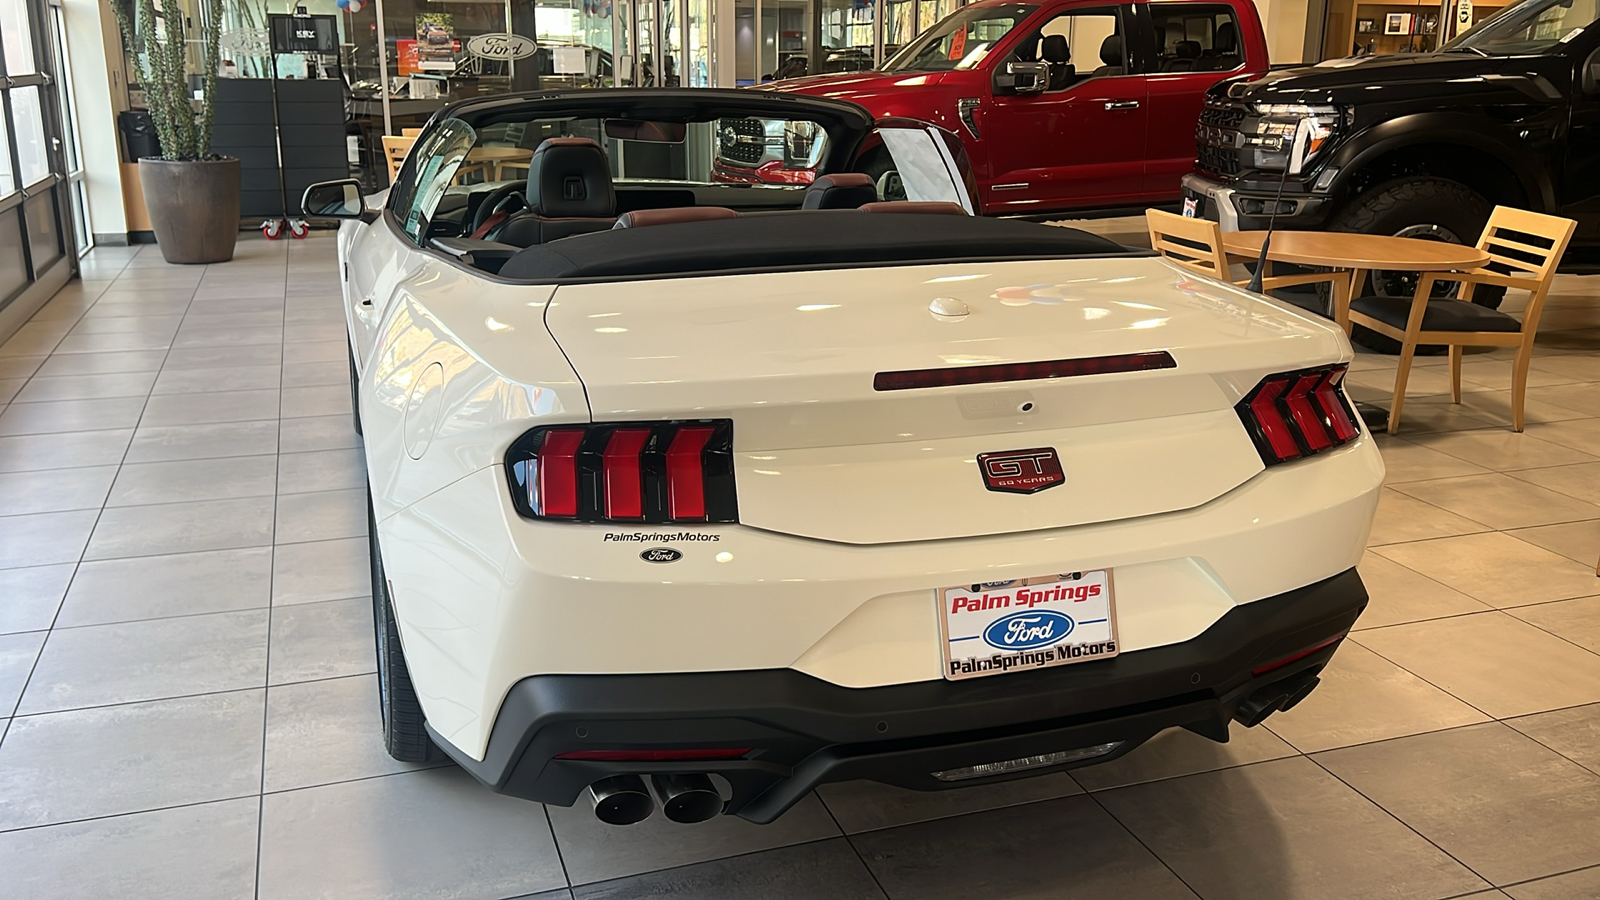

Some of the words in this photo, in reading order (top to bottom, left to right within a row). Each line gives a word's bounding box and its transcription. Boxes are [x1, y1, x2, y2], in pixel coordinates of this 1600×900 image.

[481, 37, 523, 56] Ford
[984, 452, 1053, 478] GT
[1016, 476, 1054, 484] YEARS
[603, 532, 721, 543] PalmSpringsMotors
[648, 549, 675, 561] Ford
[951, 593, 1011, 614] Palm
[1015, 583, 1102, 608] Springs
[1003, 616, 1055, 645] Ford
[950, 649, 1055, 675] PalmSprings
[1057, 641, 1116, 660] Motors
